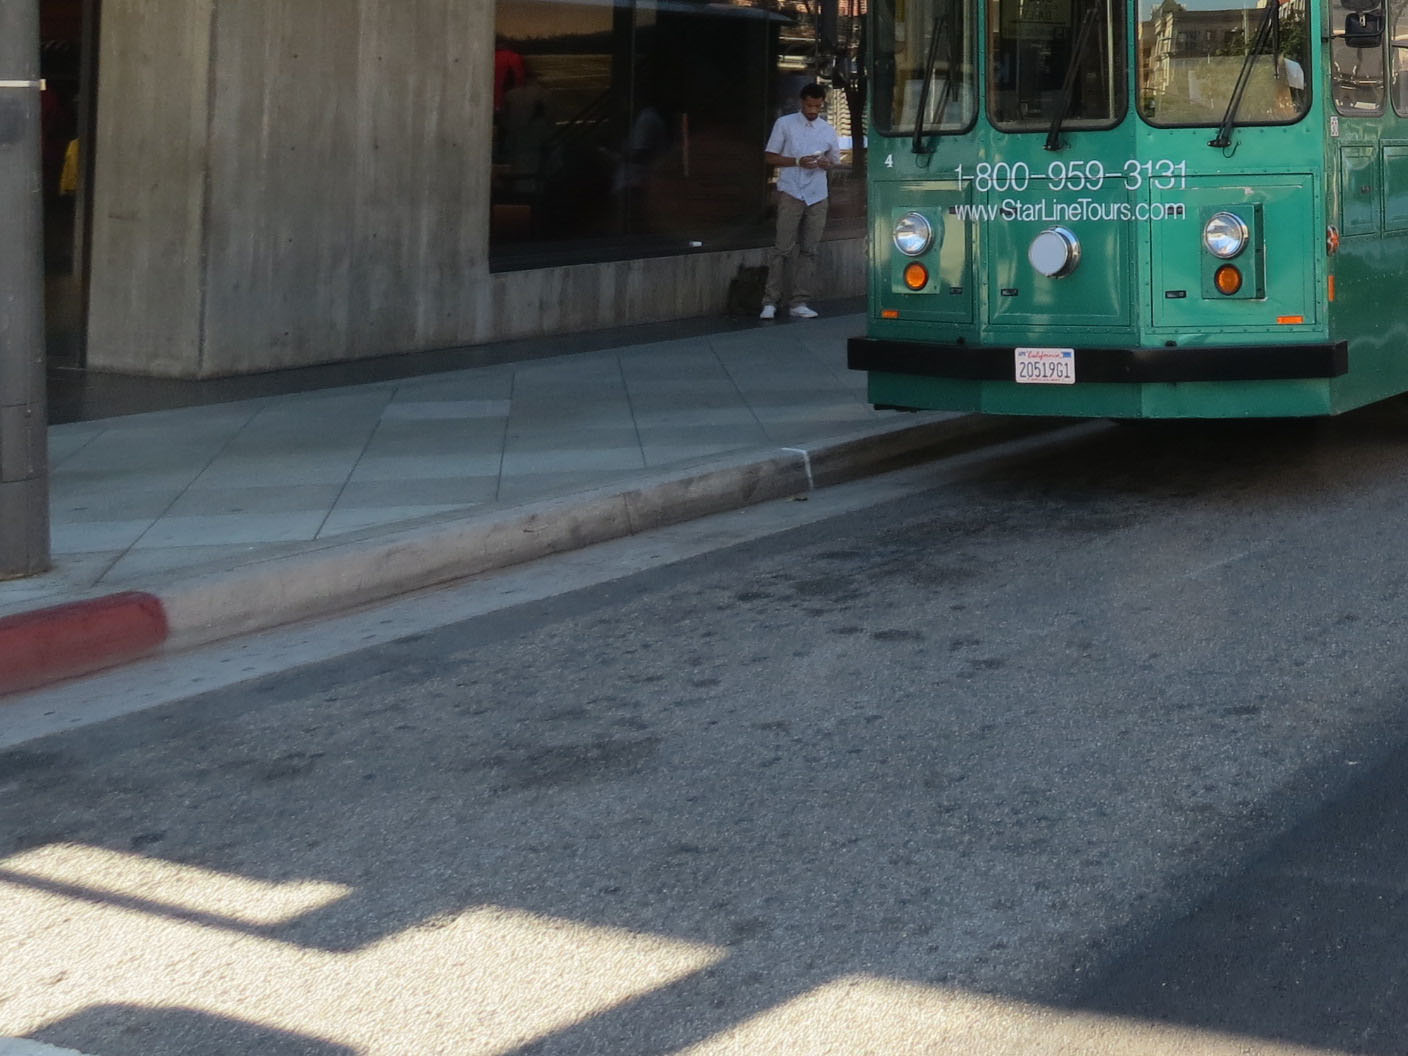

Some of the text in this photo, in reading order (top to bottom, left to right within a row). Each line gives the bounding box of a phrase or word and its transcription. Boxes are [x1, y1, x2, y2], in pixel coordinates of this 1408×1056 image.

[884, 155, 893, 167] 4
[954, 160, 1187, 192] 1-800-959-3131
[954, 198, 1186, 222] wwwStarLineTours.com
[1019, 361, 1071, 378] 20519G1
